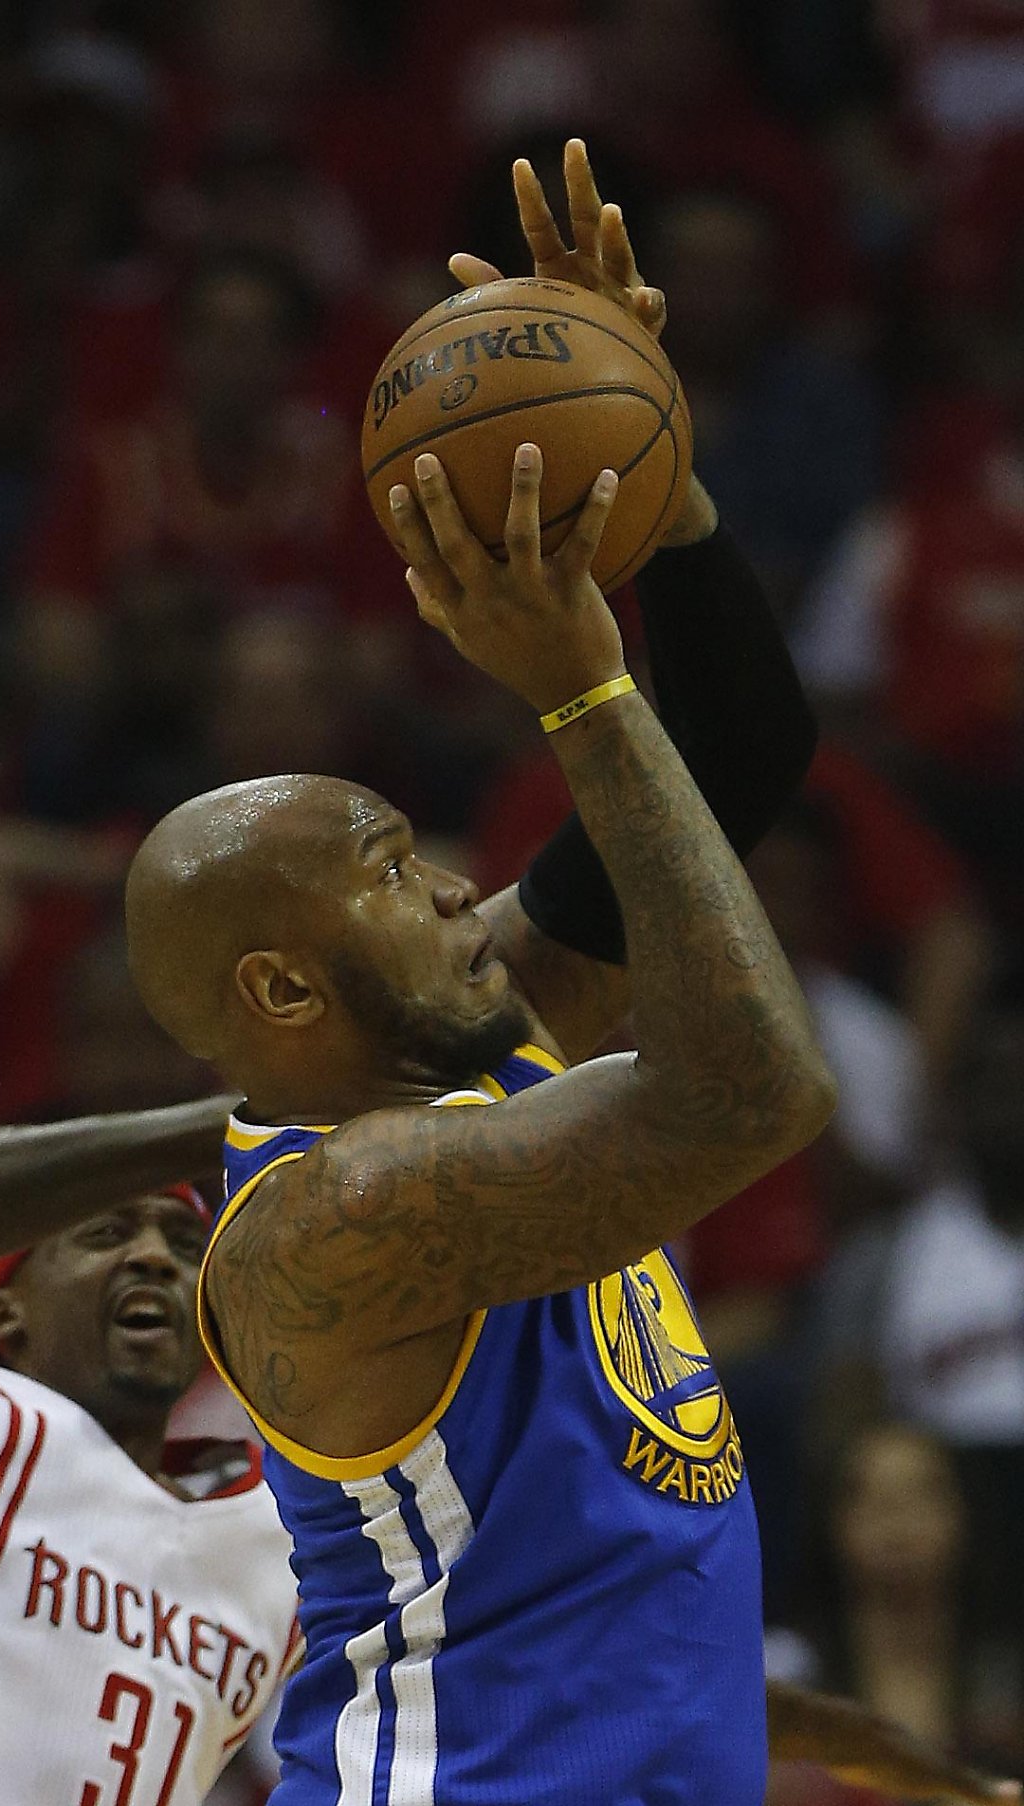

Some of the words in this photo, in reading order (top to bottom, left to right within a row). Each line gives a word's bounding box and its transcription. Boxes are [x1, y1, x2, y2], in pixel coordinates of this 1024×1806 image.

[374, 321, 574, 431] SPALDING
[622, 1421, 744, 1505] WARRIO
[24, 1537, 269, 1719] ROCKETS
[78, 1671, 196, 1806] 31
